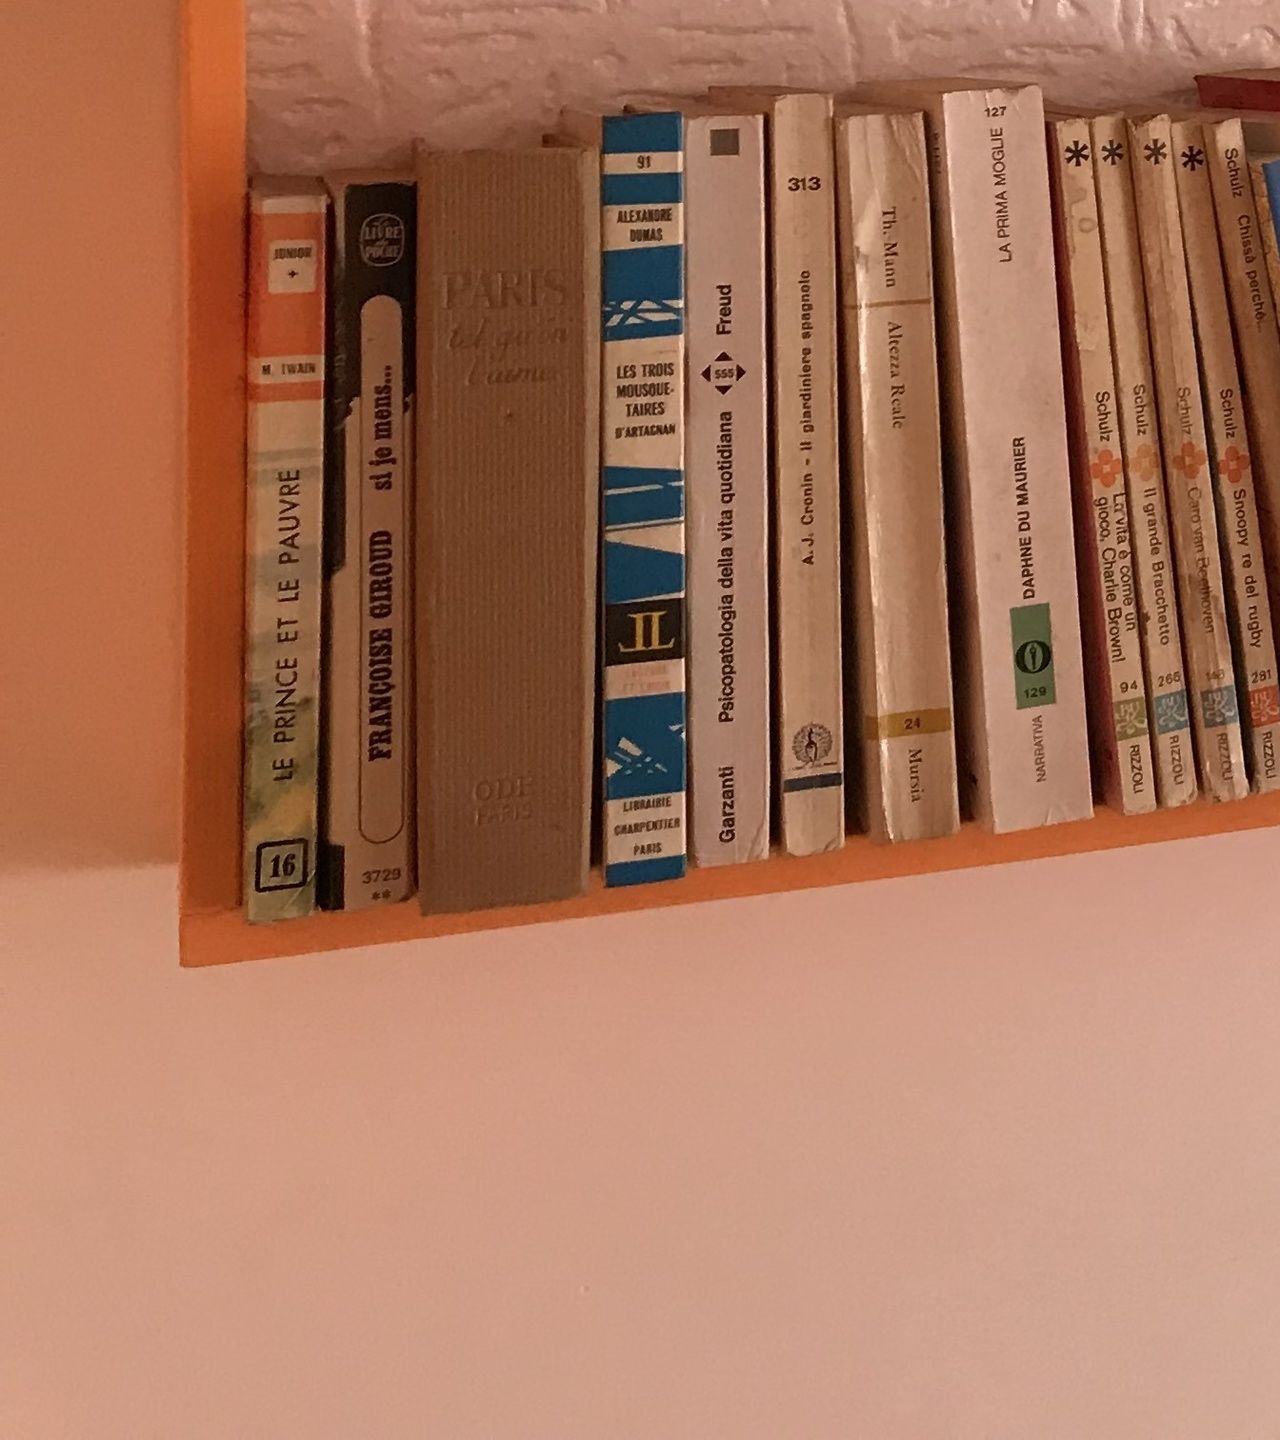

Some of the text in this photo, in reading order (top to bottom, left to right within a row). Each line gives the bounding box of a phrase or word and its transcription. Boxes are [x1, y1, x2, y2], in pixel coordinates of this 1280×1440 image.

[983, 105, 1008, 118] 127
[636, 155, 652, 170] 91
[787, 176, 821, 192] 313
[616, 208, 673, 224] ALEXANDRE
[988, 126, 1013, 263] LA PRIMA MOGLIE
[1224, 147, 1258, 264] Schulz Chissà
[273, 246, 312, 261] JUNIOR
[629, 228, 663, 243] DUMAS
[881, 206, 899, 288] Th. Mann
[440, 269, 569, 310] PARIS
[715, 284, 733, 336] Freud
[616, 361, 675, 380] LES TROIS
[616, 381, 675, 399] MOUSQUE-
[887, 321, 907, 430] Altezza Reale
[373, 364, 398, 491] si je mens...
[615, 423, 676, 440] D'ARTAGNAN
[625, 401, 666, 418] TAIRES
[797, 269, 815, 566] A. Cronin giardiniere spagnolo
[1094, 390, 1114, 443] Schulz
[1132, 383, 1149, 437] Schulz
[1177, 386, 1194, 436] Schulz
[1219, 387, 1238, 439] Schulz
[1012, 435, 1036, 600] DAPHNE DU MAURIER
[716, 410, 737, 724] Psicopatologia della vita quotidiana
[1093, 496, 1118, 603] gioco, Charlie
[1114, 515, 1136, 632] vita come un
[1142, 503, 1171, 646] grande Bracchetto
[1186, 486, 1215, 634] Caro van Beethoven
[1233, 488, 1264, 649] Snoopy re del rugby
[272, 468, 301, 782] LE PRINCE ET LE PAUVRE
[367, 529, 397, 763] FRANÇOISE GIROUD
[1023, 685, 1048, 699] 129
[1119, 680, 1139, 694] 94
[1251, 669, 1273, 684] 281
[904, 717, 921, 731] 24
[1034, 714, 1048, 784] NARRATIVA
[908, 747, 926, 804] Mursia
[1129, 743, 1145, 795] RIZZOLI
[1168, 734, 1185, 786] RIZZOLI
[1216, 732, 1235, 782] RIZZOLI
[1262, 730, 1277, 779] RIZZOLI
[613, 817, 681, 837] CHARPENTIER
[622, 795, 672, 813] LIBRAIRIE
[718, 766, 736, 843] Garzanti
[269, 853, 297, 878] 16
[632, 842, 663, 857] PARIS
[361, 867, 402, 885] 3729
